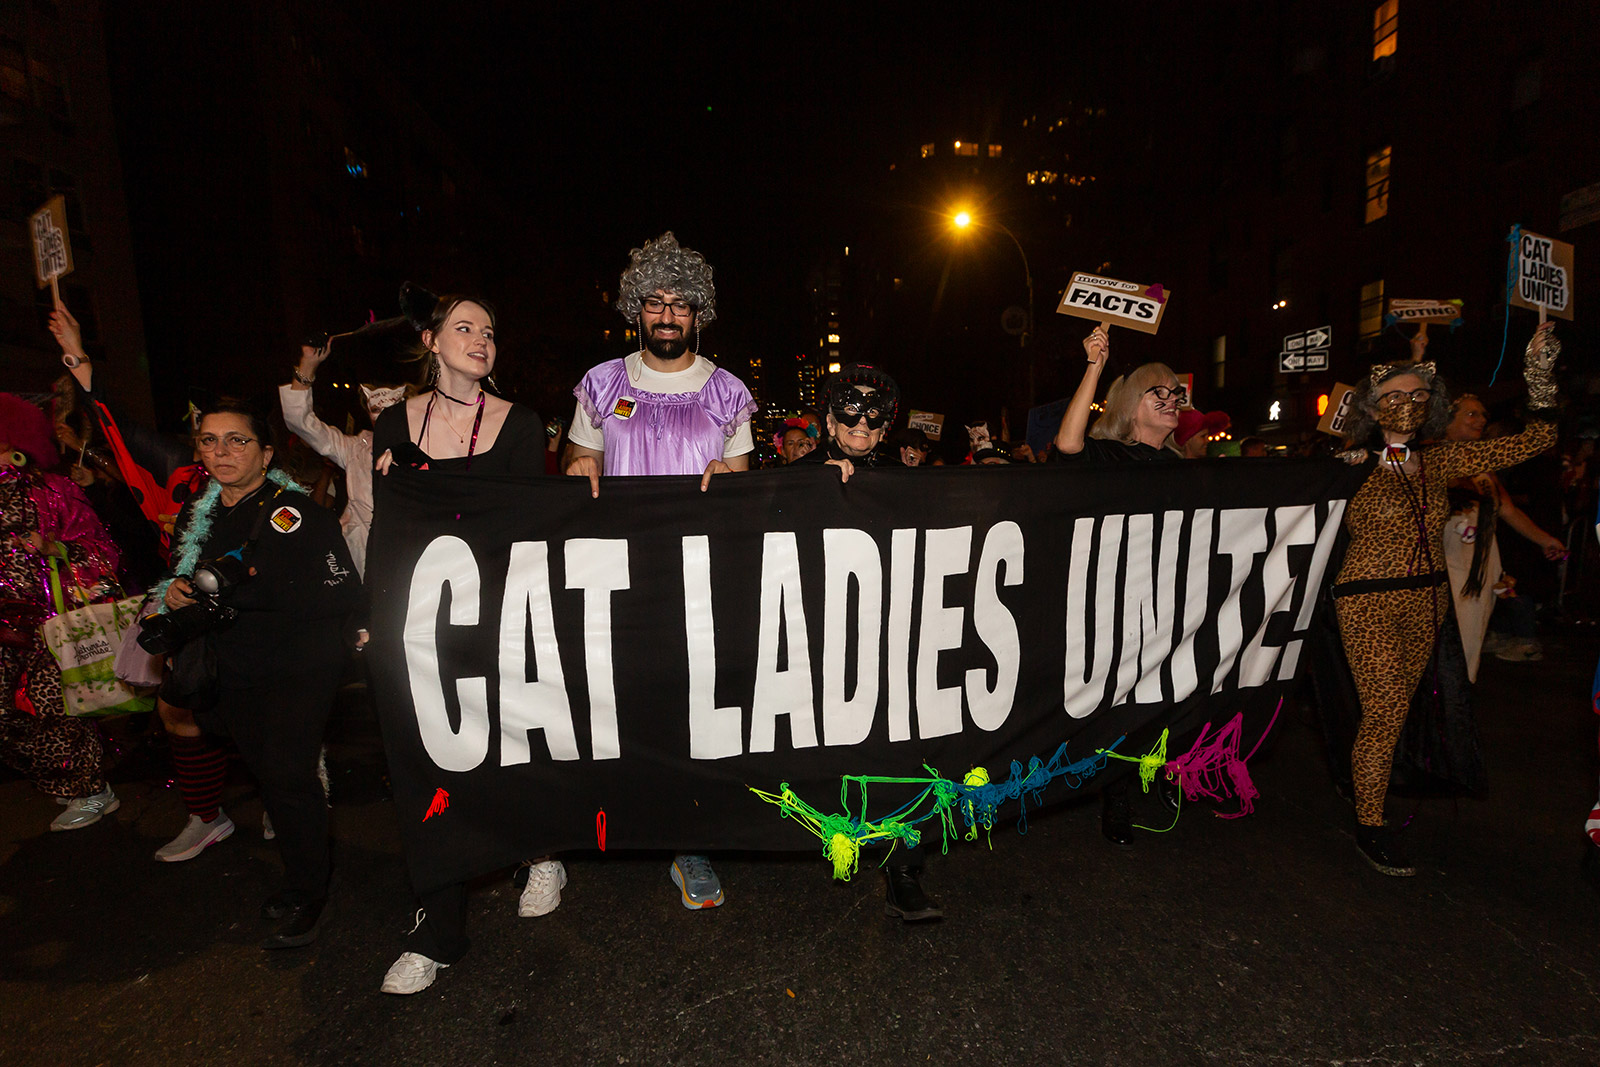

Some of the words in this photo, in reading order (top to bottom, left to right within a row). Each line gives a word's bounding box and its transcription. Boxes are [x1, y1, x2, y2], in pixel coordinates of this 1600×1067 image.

[1522, 235, 1550, 264] CAT
[1077, 275, 1119, 287] meow
[1120, 282, 1137, 290] for
[1522, 259, 1563, 287] LADIES
[1069, 288, 1156, 319] FACTS
[1522, 278, 1564, 308] UNITE!
[1393, 307, 1456, 318] VOTING
[911, 421, 940, 434] CHOICE
[403, 535, 631, 772] CAT
[682, 520, 1025, 760] LADIES
[1064, 499, 1347, 719] UNITE!
